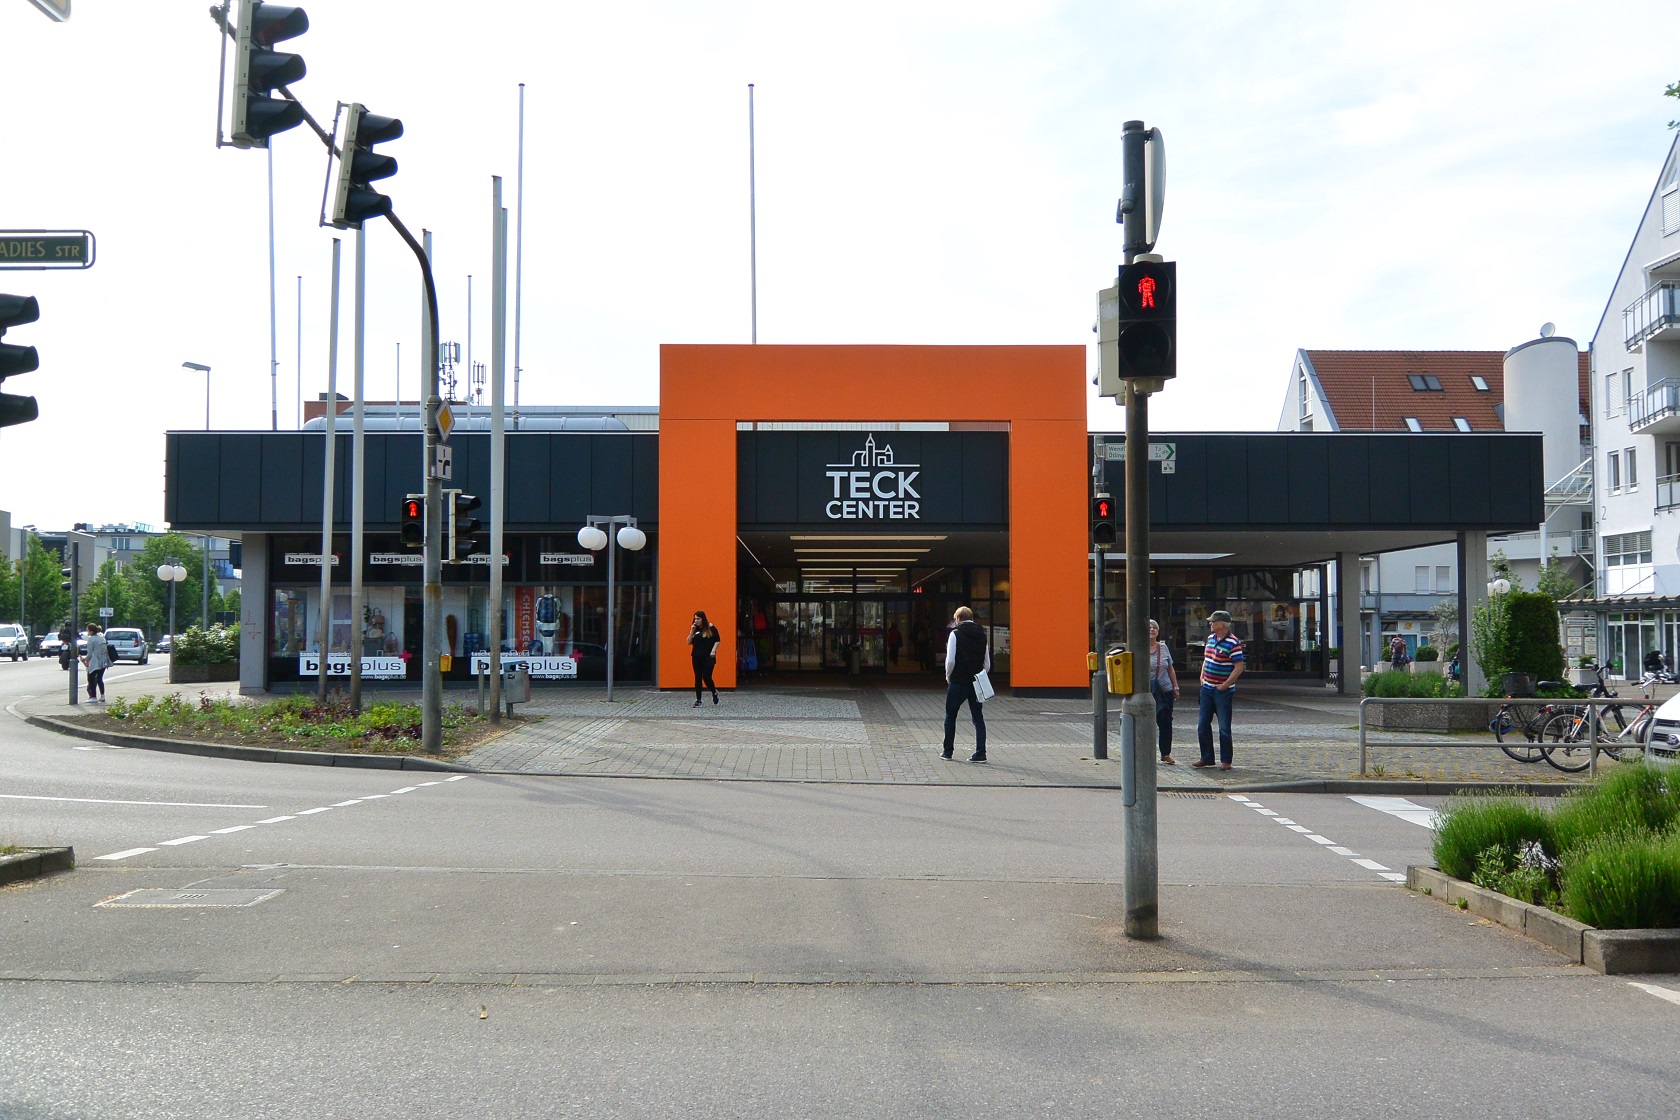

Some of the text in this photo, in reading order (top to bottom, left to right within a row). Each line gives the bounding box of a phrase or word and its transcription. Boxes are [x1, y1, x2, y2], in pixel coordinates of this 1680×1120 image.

[55, 245, 80, 257] STR
[826, 471, 921, 498] TECK
[825, 500, 920, 519] CENTER
[1601, 505, 1607, 520] 2
